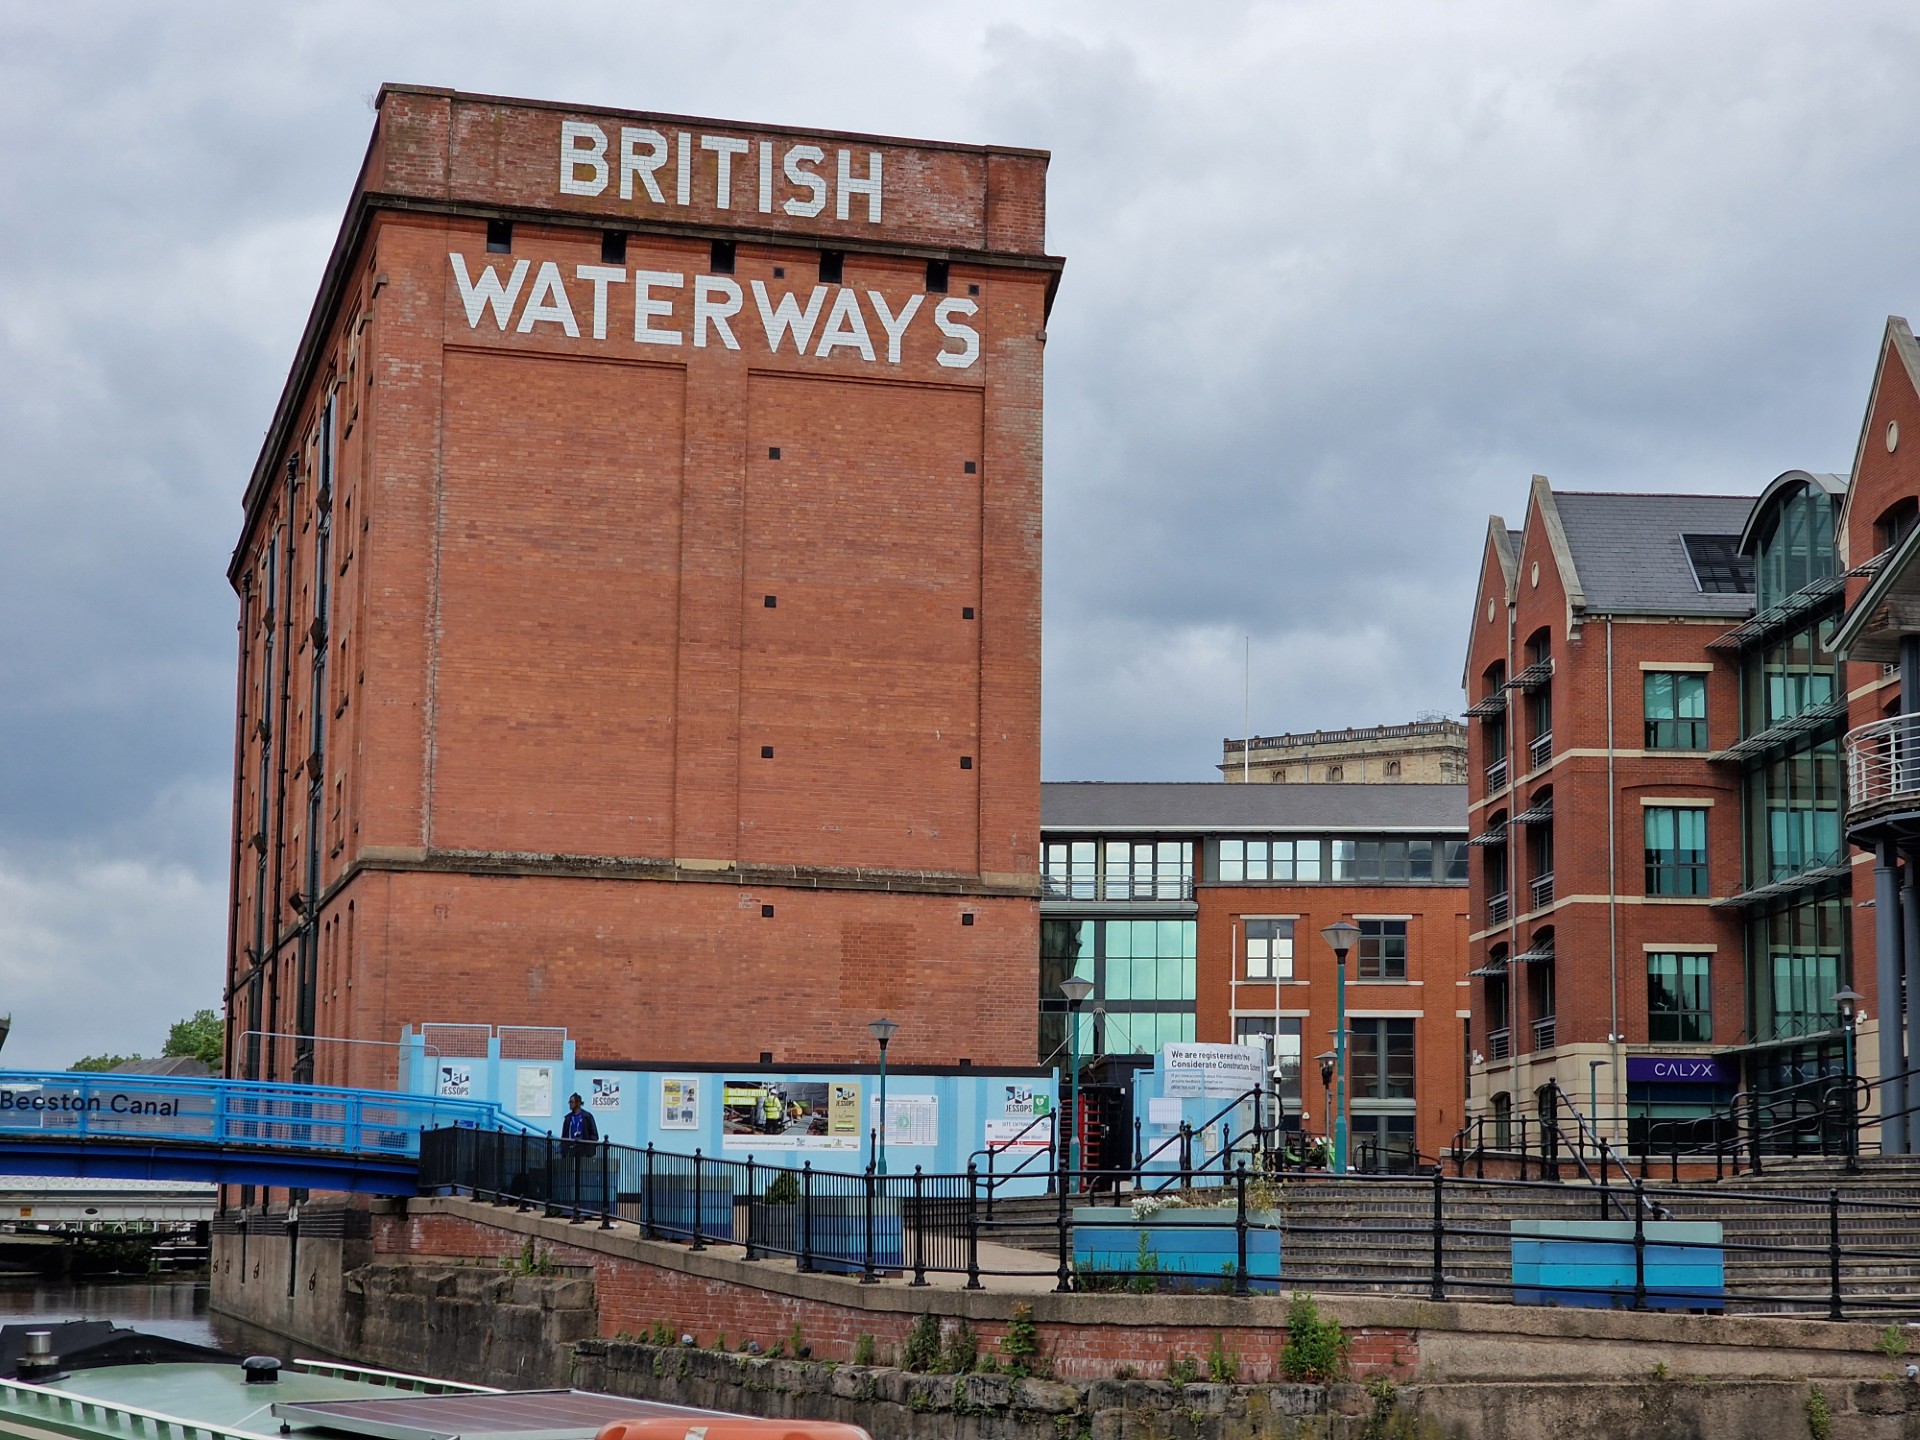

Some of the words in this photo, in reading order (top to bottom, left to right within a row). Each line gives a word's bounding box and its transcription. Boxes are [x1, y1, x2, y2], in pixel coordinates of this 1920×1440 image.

[560, 120, 883, 224] BRITISH
[449, 252, 980, 369] WATERWAYS
[1171, 1050, 1183, 1059] We
[1184, 1051, 1198, 1059] are
[1199, 1051, 1233, 1061] registered
[1171, 1060, 1217, 1069] Considerate
[1654, 1063, 1712, 1077] CALYX
[441, 1086, 469, 1096] JESSOPS
[0, 1090, 101, 1111] Beeston
[110, 1094, 179, 1117] Canal
[592, 1096, 620, 1106] JESSOPS
[1005, 1104, 1033, 1113] JESSOPS
